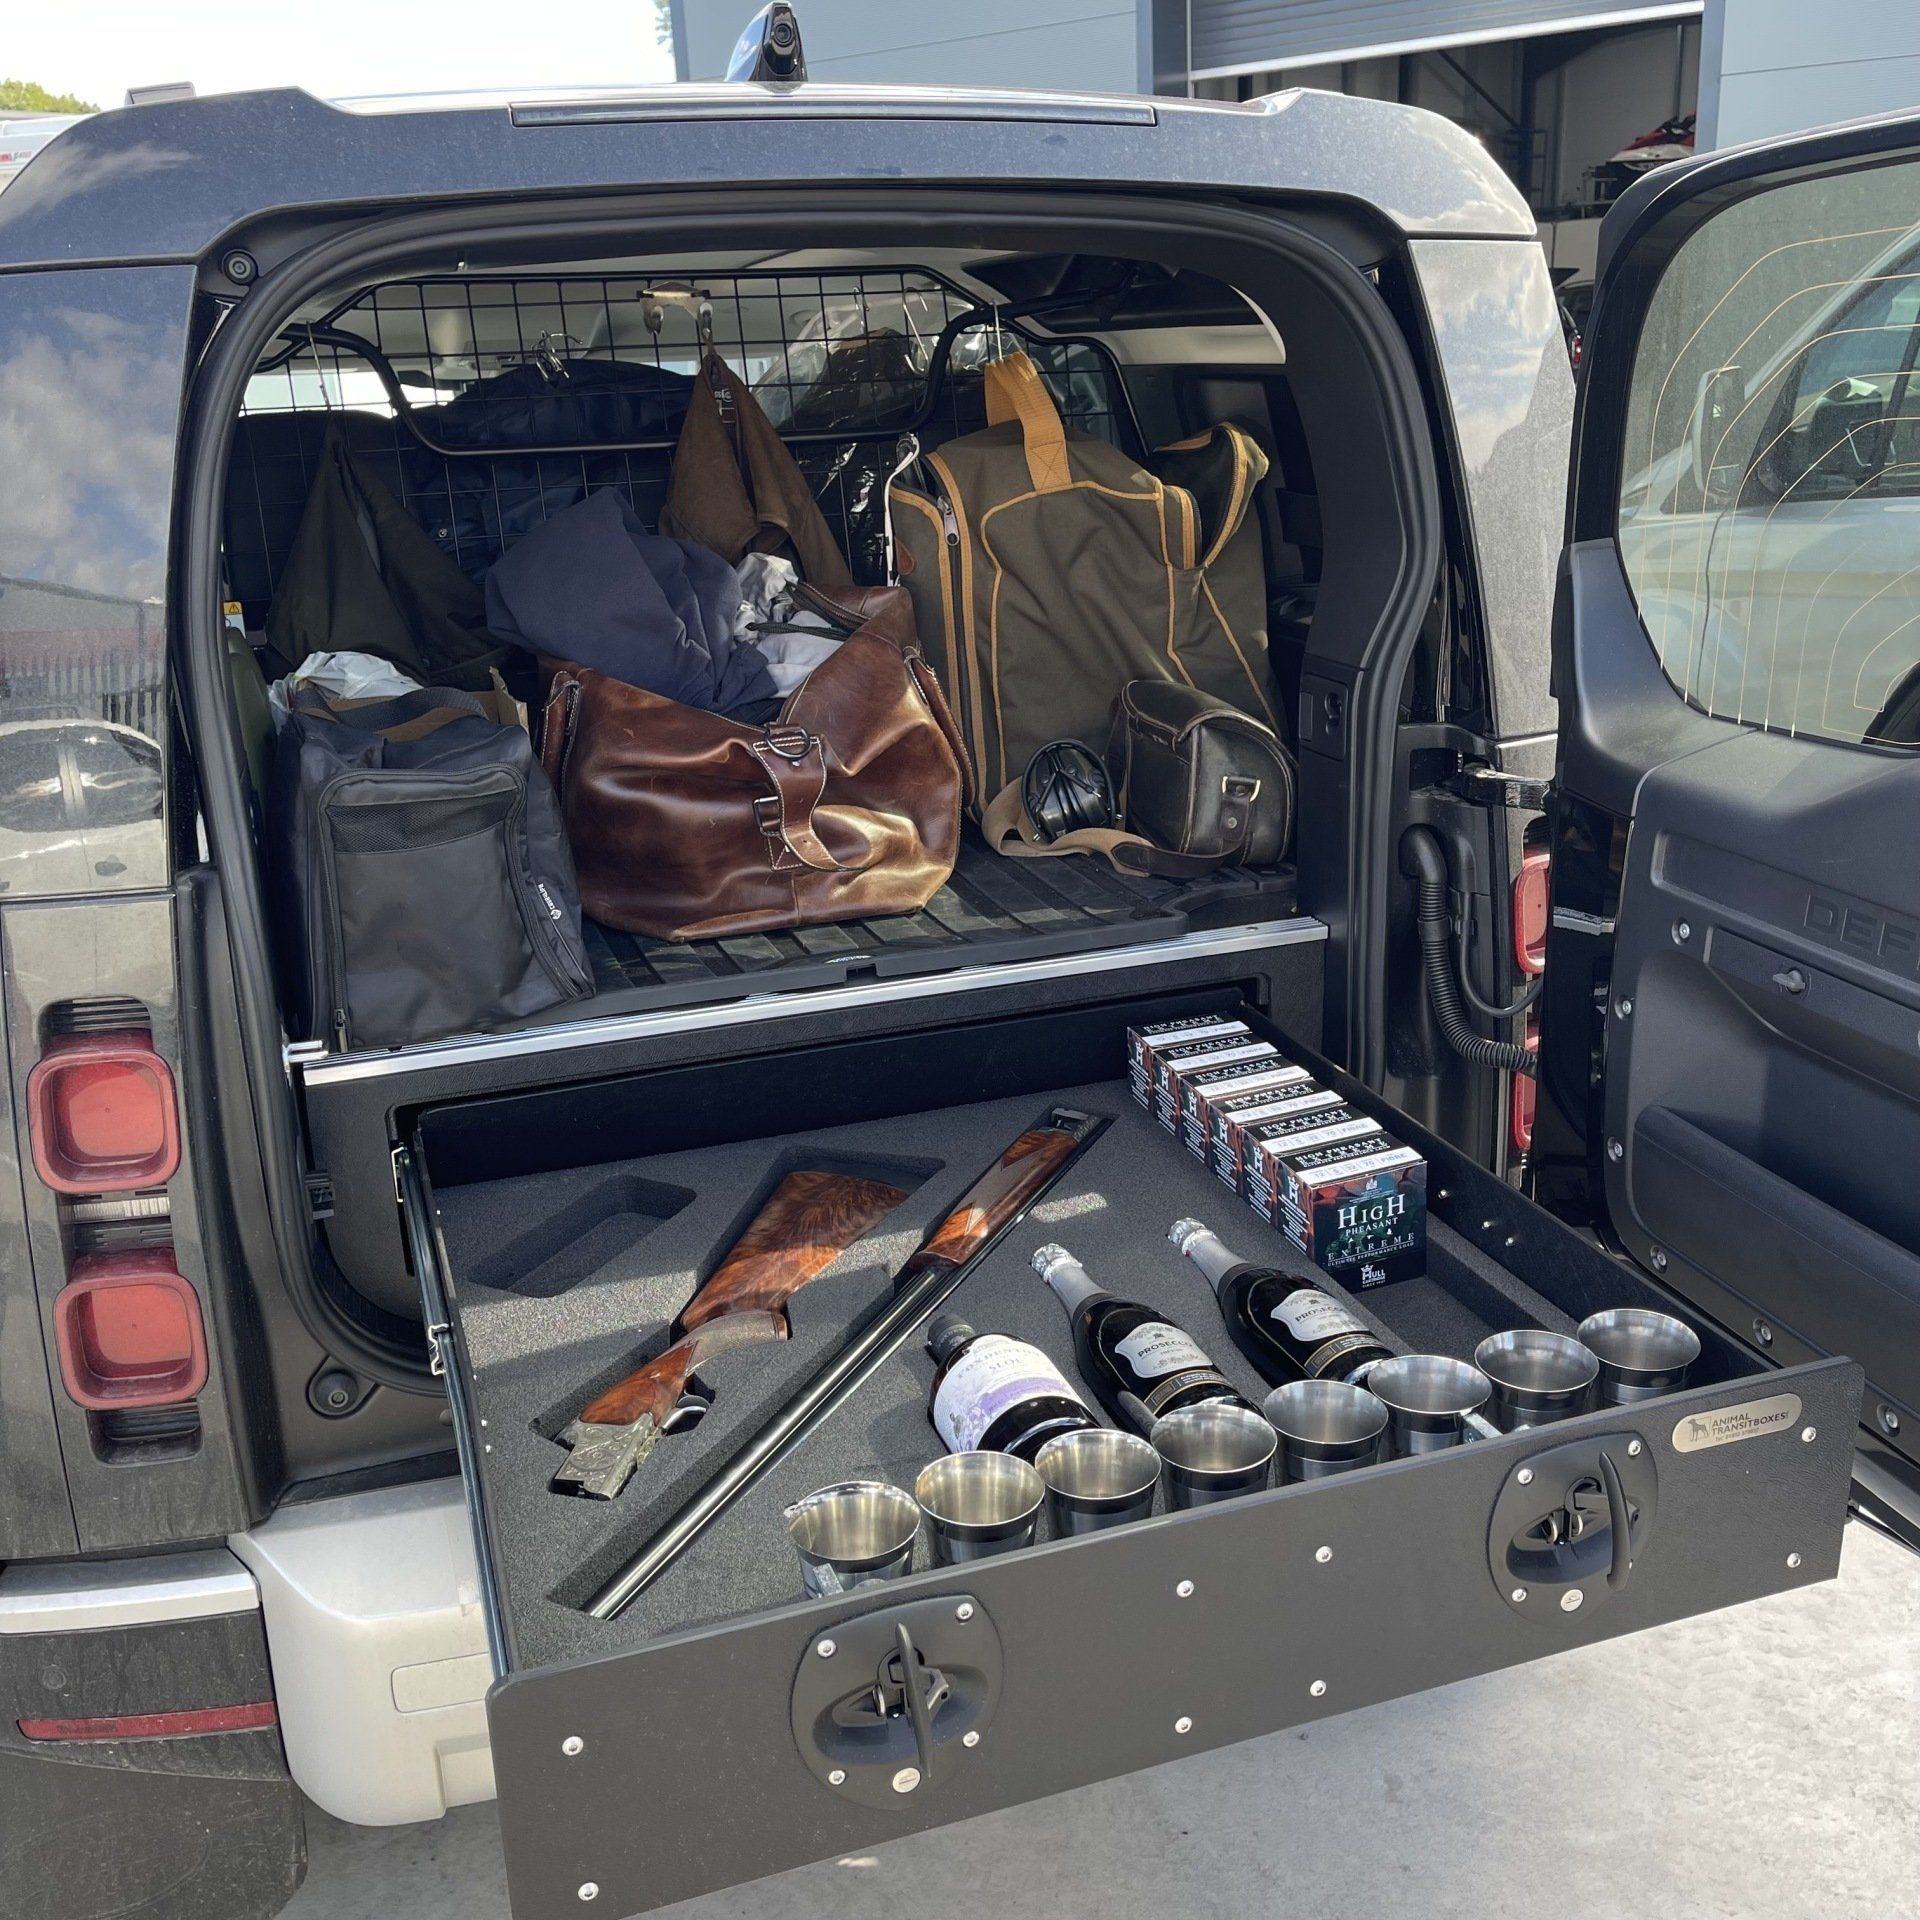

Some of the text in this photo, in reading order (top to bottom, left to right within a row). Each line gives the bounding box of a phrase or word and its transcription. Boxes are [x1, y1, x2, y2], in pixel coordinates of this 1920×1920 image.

[1803, 895, 1920, 970] DEF
[1337, 1193, 1406, 1229] HIGH
[1345, 1217, 1399, 1237] PHEASANT
[1328, 1232, 1415, 1260] EXTREME
[1137, 1340, 1194, 1358] PROSECCO
[1711, 1413, 1751, 1428] ANIMAL
